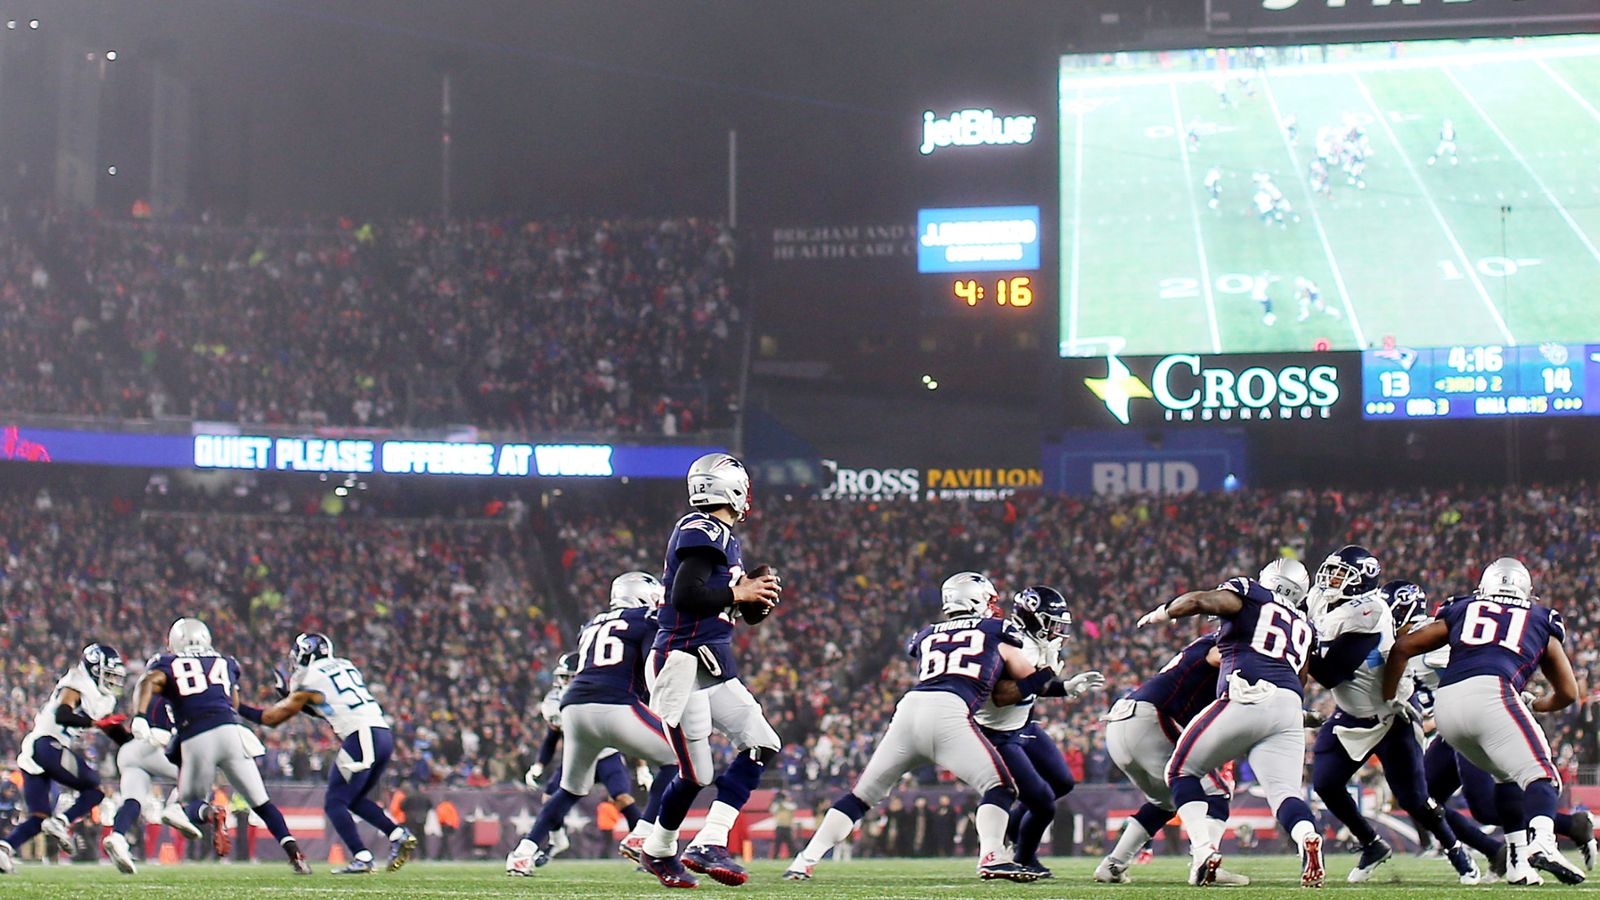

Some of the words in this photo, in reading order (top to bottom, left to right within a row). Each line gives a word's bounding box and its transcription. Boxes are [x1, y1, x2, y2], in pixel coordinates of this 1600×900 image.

[920, 109, 1036, 154] jetBlue
[773, 227, 859, 242] BRIGHAM
[866, 226, 905, 239] AND
[773, 243, 846, 259] HEALTH
[1448, 346, 1503, 373] 4:16
[1379, 371, 1410, 398] 13
[1542, 367, 1573, 394] 14
[194, 435, 273, 469] QUIET
[275, 438, 375, 472] PLEASE
[381, 441, 495, 475] OFFENSE
[497, 444, 533, 475] AT
[534, 444, 614, 476] WORK
[693, 483, 706, 494] 12
[926, 468, 1043, 488] PAVILION
[1092, 461, 1199, 496] BUD
[1276, 584, 1291, 597] 69
[1250, 602, 1313, 676] 69
[1460, 600, 1530, 656] 61
[575, 619, 630, 675] 76
[918, 628, 986, 682] 62
[170, 657, 231, 697] 84
